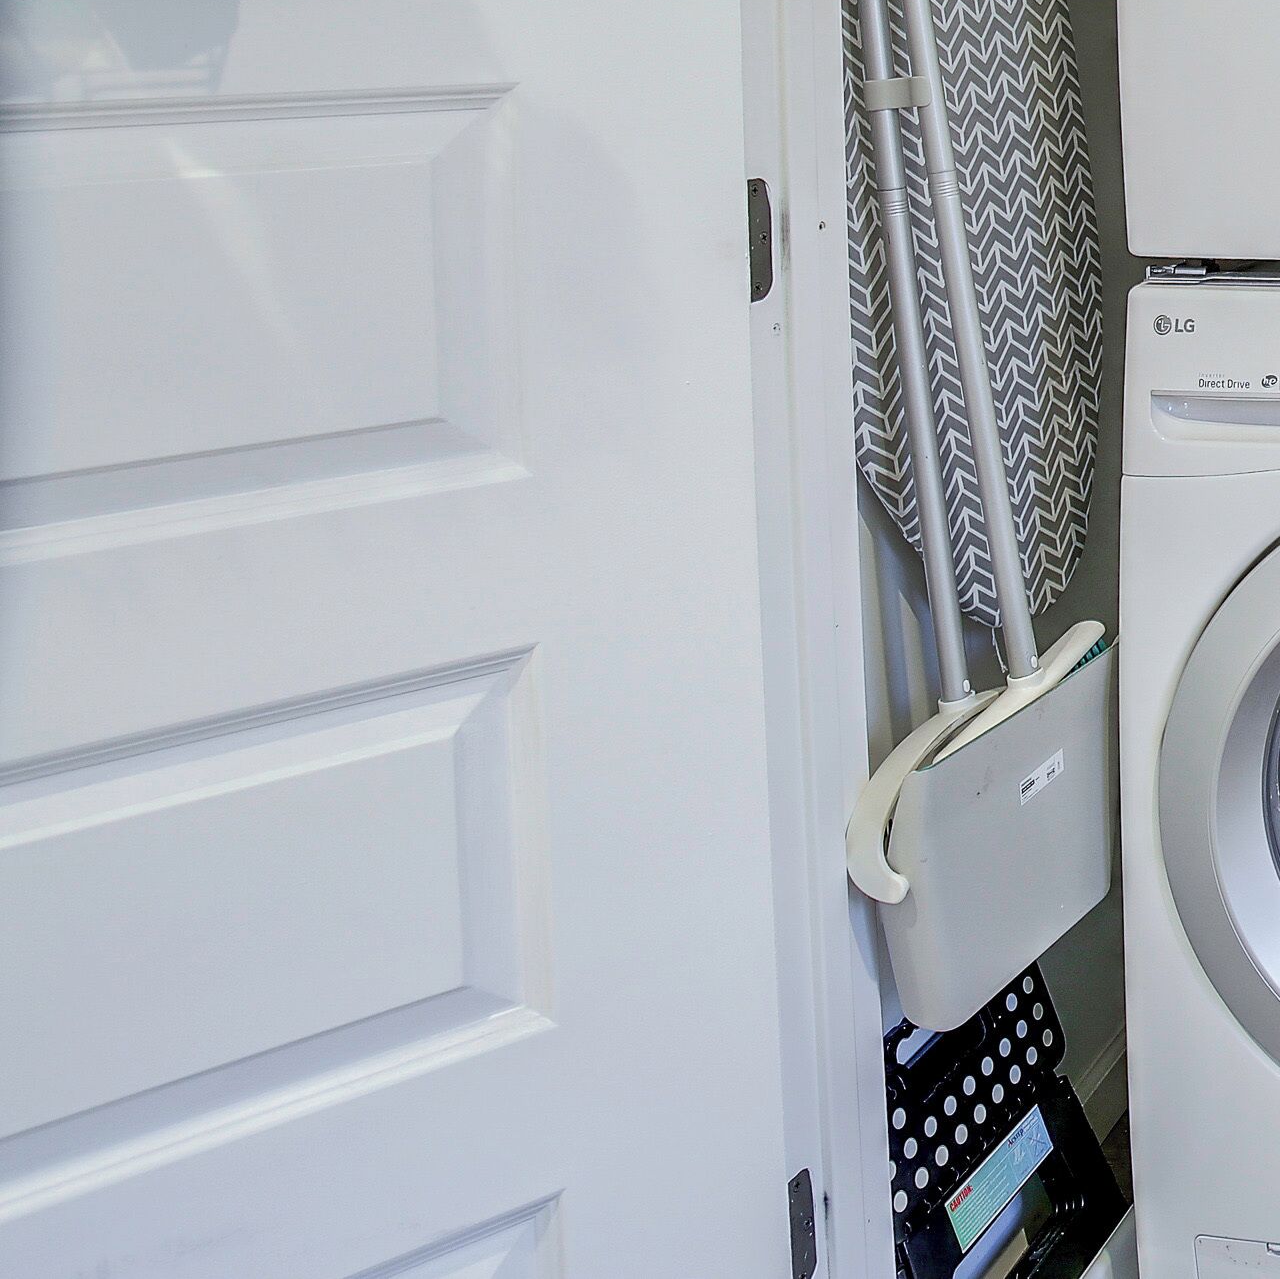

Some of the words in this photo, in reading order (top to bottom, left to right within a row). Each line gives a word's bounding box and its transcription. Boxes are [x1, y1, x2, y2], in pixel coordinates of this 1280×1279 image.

[1174, 319, 1195, 333] LG
[1198, 378, 1225, 389] Direct
[1227, 379, 1250, 389] Drive
